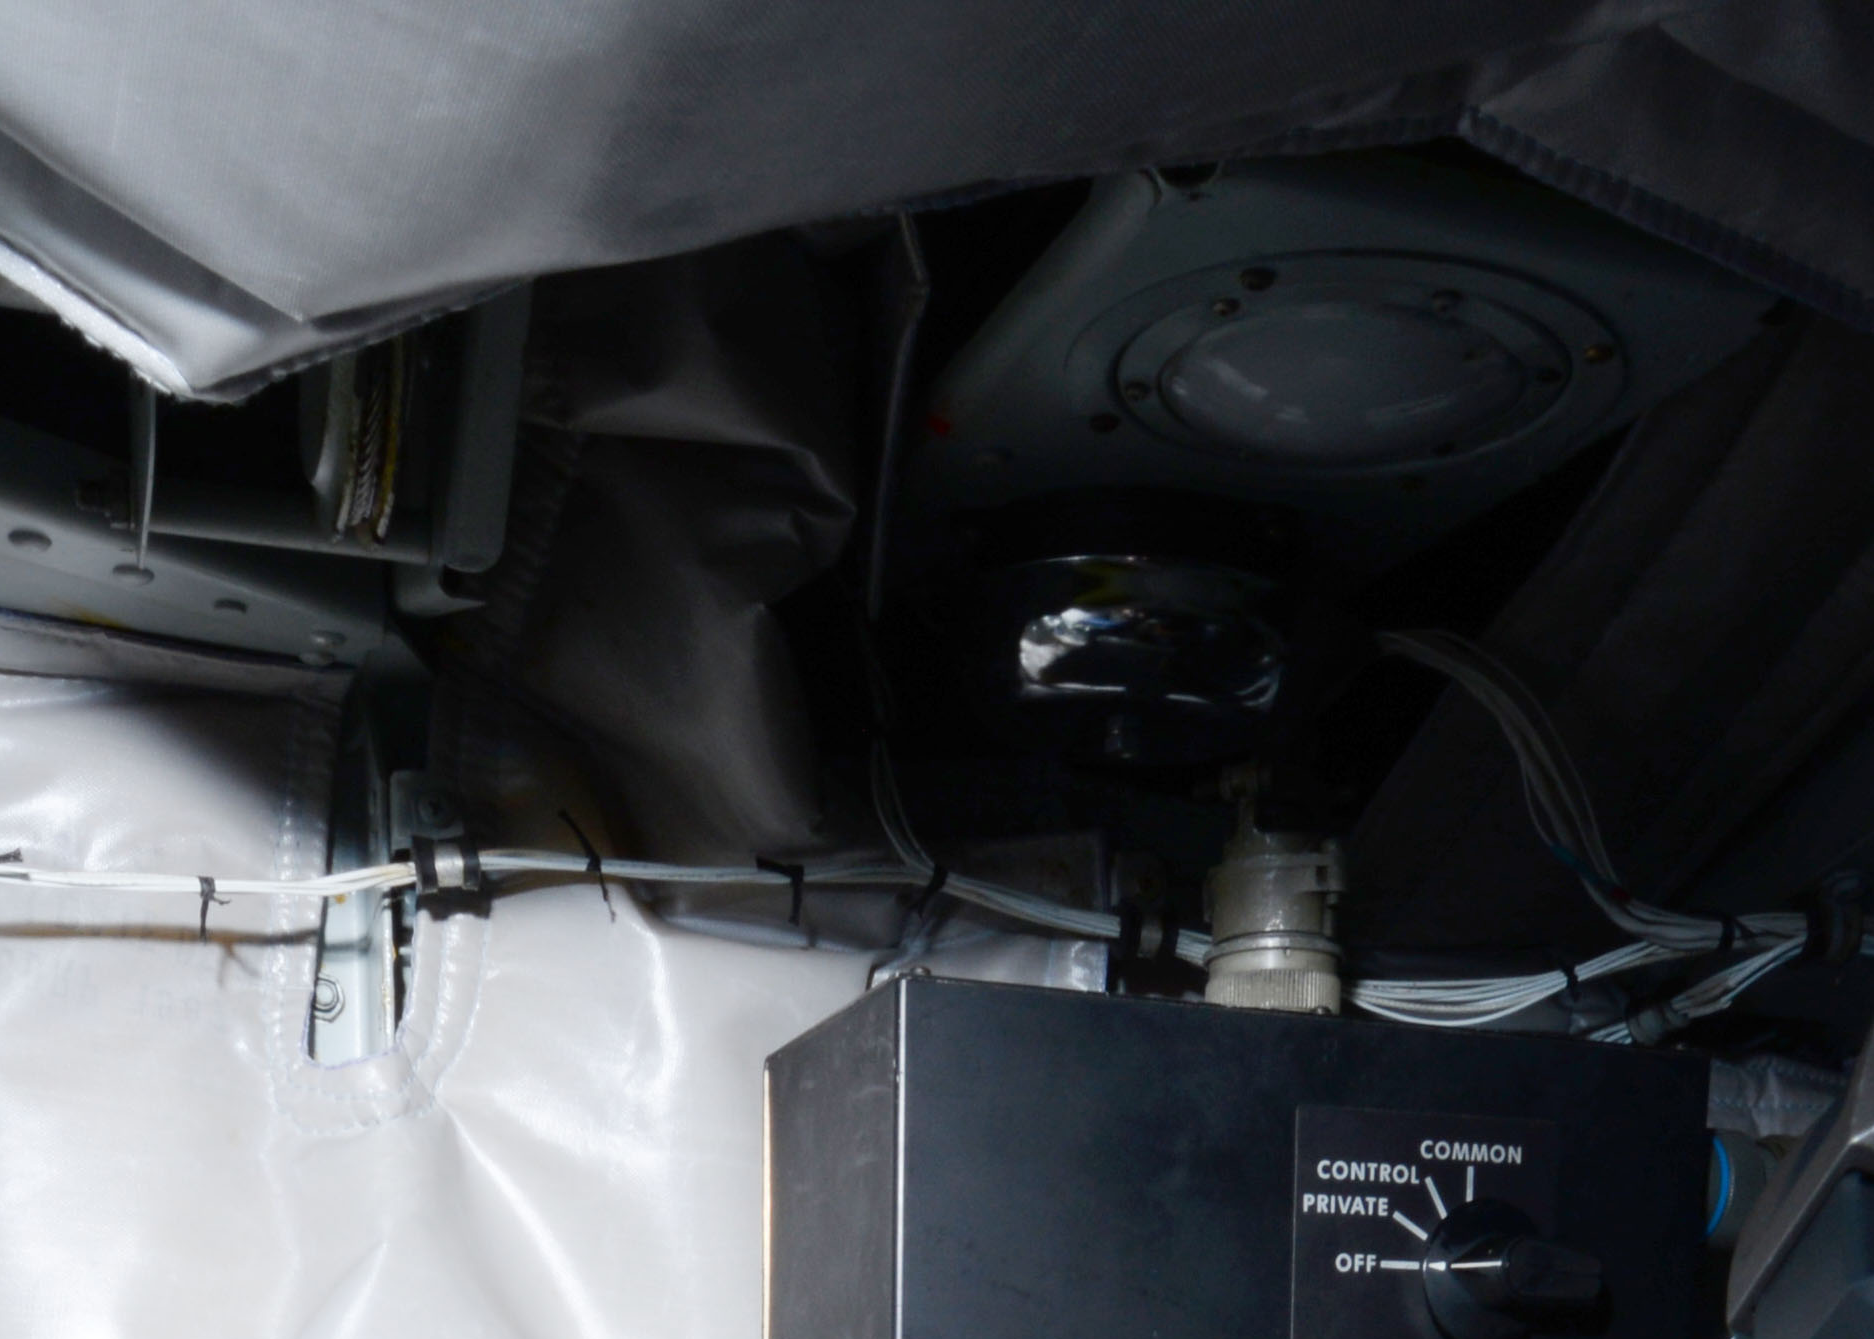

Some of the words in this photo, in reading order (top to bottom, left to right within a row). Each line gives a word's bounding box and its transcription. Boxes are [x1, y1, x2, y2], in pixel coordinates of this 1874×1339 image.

[1420, 1140, 1522, 1165] COMMON
[1317, 1160, 1419, 1184] CONTROL
[1302, 1194, 1388, 1216] PRIVATE
[1335, 1253, 1376, 1273] OFF
